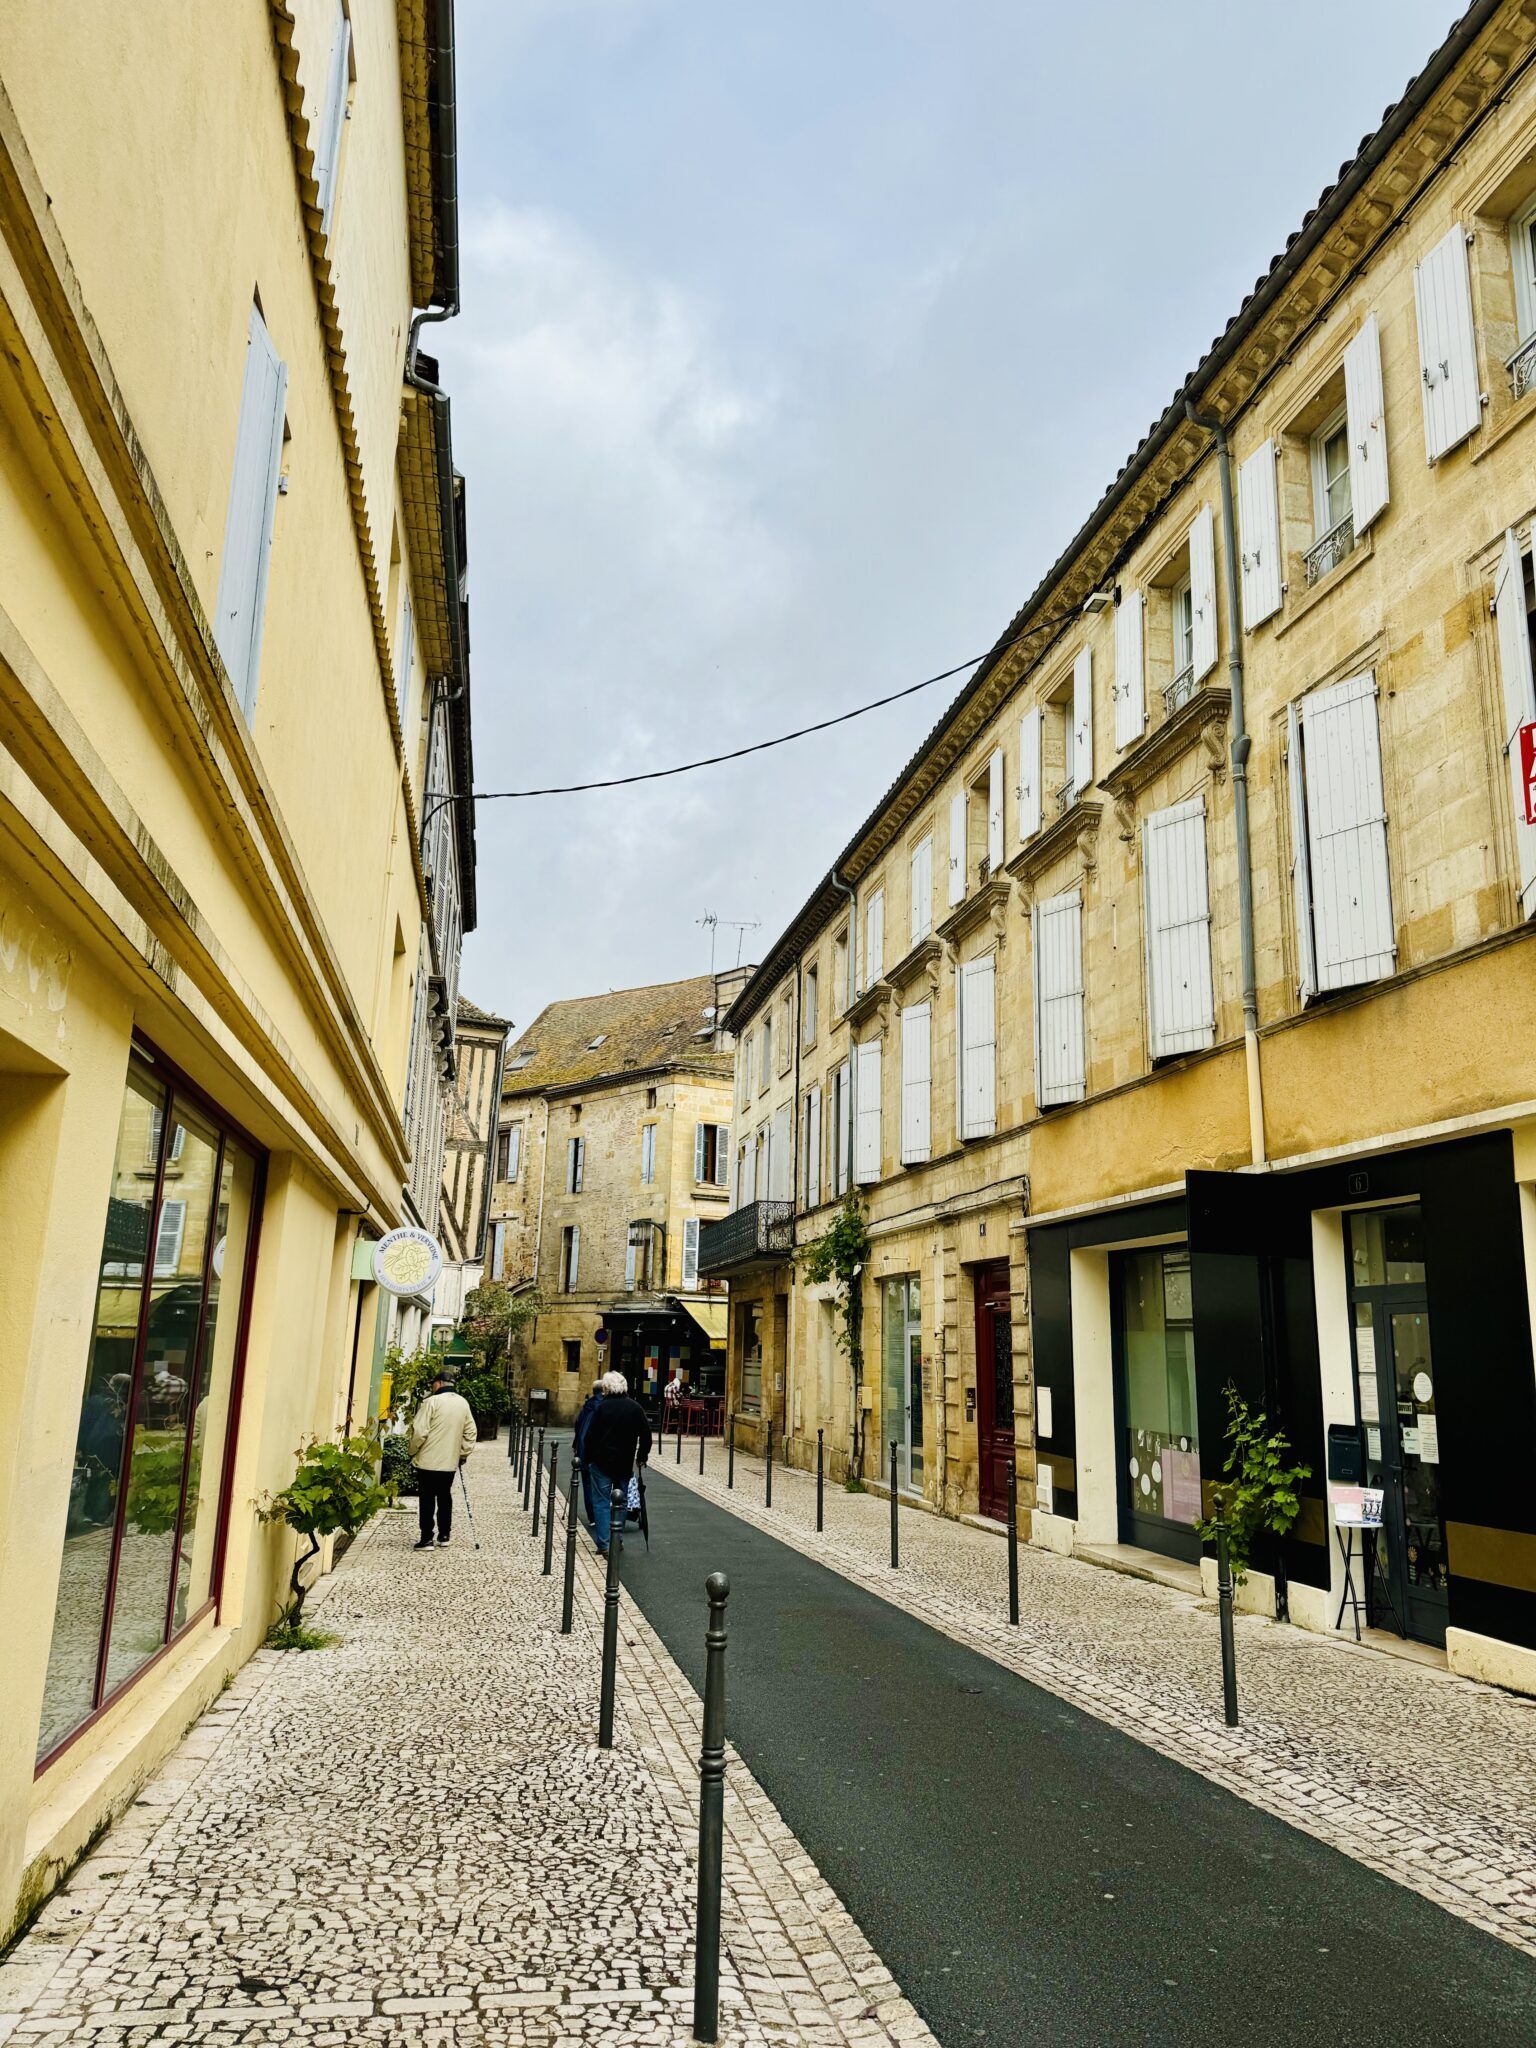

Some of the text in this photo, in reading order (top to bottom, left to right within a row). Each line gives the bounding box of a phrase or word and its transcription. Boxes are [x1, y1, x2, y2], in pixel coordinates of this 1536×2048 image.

[1355, 1175, 1362, 1191] 6
[379, 1232, 408, 1253] MENTHE
[417, 1233, 439, 1261] VERVEINE
